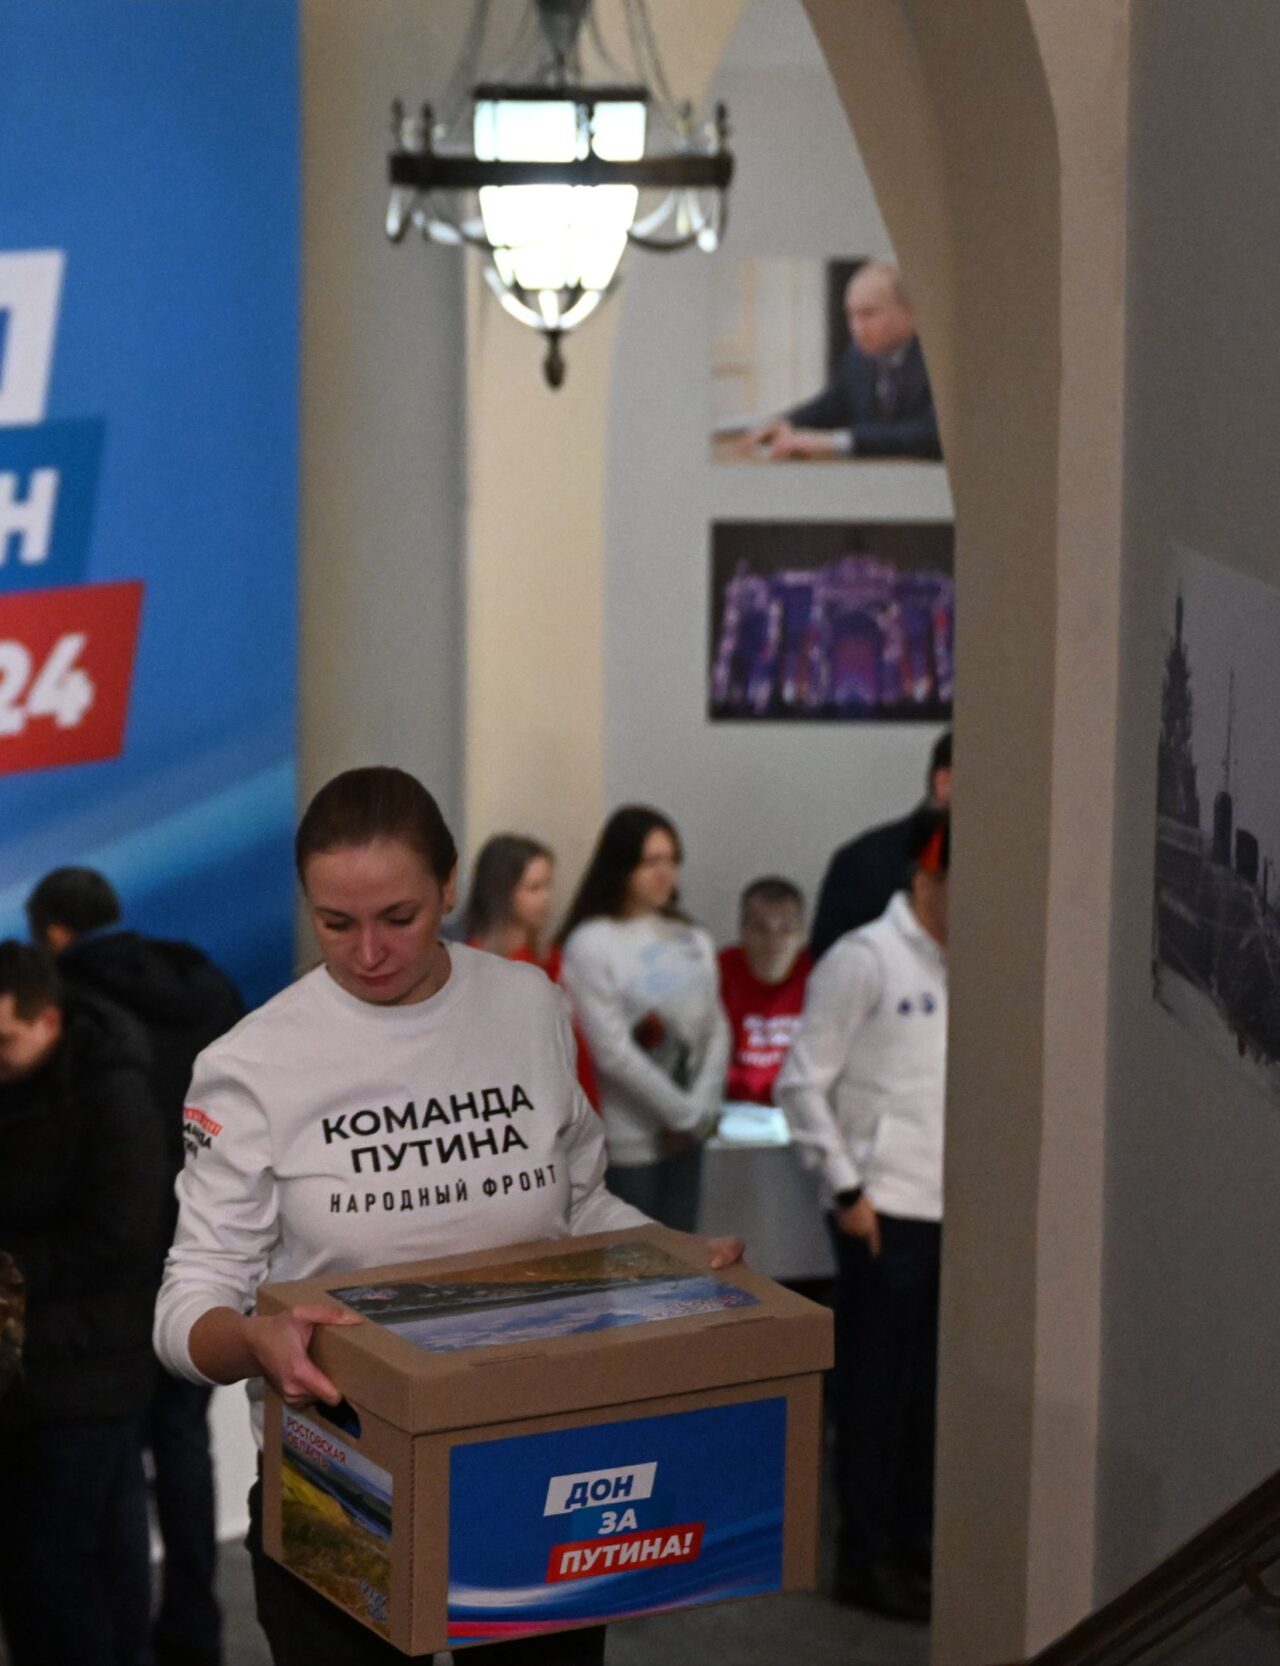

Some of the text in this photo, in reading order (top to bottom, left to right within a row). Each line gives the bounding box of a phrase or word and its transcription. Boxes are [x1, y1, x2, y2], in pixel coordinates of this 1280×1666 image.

[322, 1084, 535, 1144] КОМАНДА
[351, 1124, 529, 1173] ПУТИНА
[330, 1164, 557, 1213] НАРОДНЫЙ ФРОНТ
[286, 1416, 346, 1465] РОСТОВСКАЯ
[564, 1475, 634, 1510] ДОН
[598, 1508, 638, 1535] ЗА
[559, 1532, 694, 1575] ПУТИНА!
